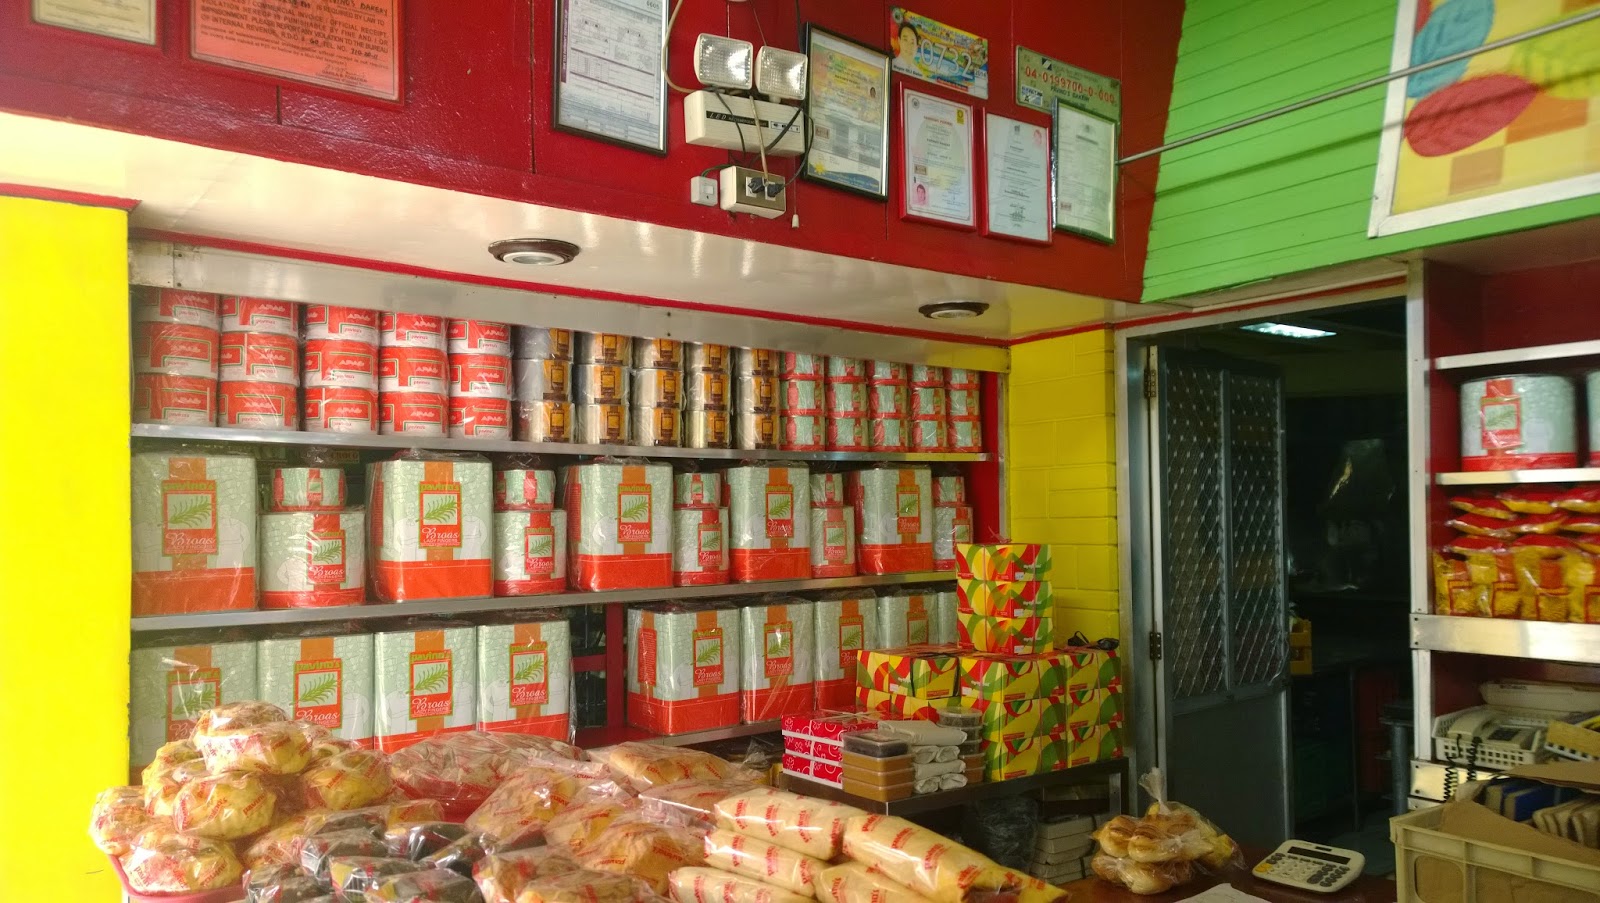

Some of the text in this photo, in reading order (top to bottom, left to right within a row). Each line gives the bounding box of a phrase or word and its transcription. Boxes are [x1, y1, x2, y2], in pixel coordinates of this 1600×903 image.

[921, 38, 974, 80] 0732
[419, 484, 460, 493] pavino's
[421, 527, 460, 540] Broas
[619, 525, 651, 535] Broas
[165, 532, 215, 545] Broas
[309, 566, 345, 577] Broas
[410, 651, 451, 661] pavino's
[295, 661, 341, 672] pavino's
[511, 686, 546, 698] Broas
[411, 697, 451, 710] Broas
[296, 709, 341, 721] Broas
